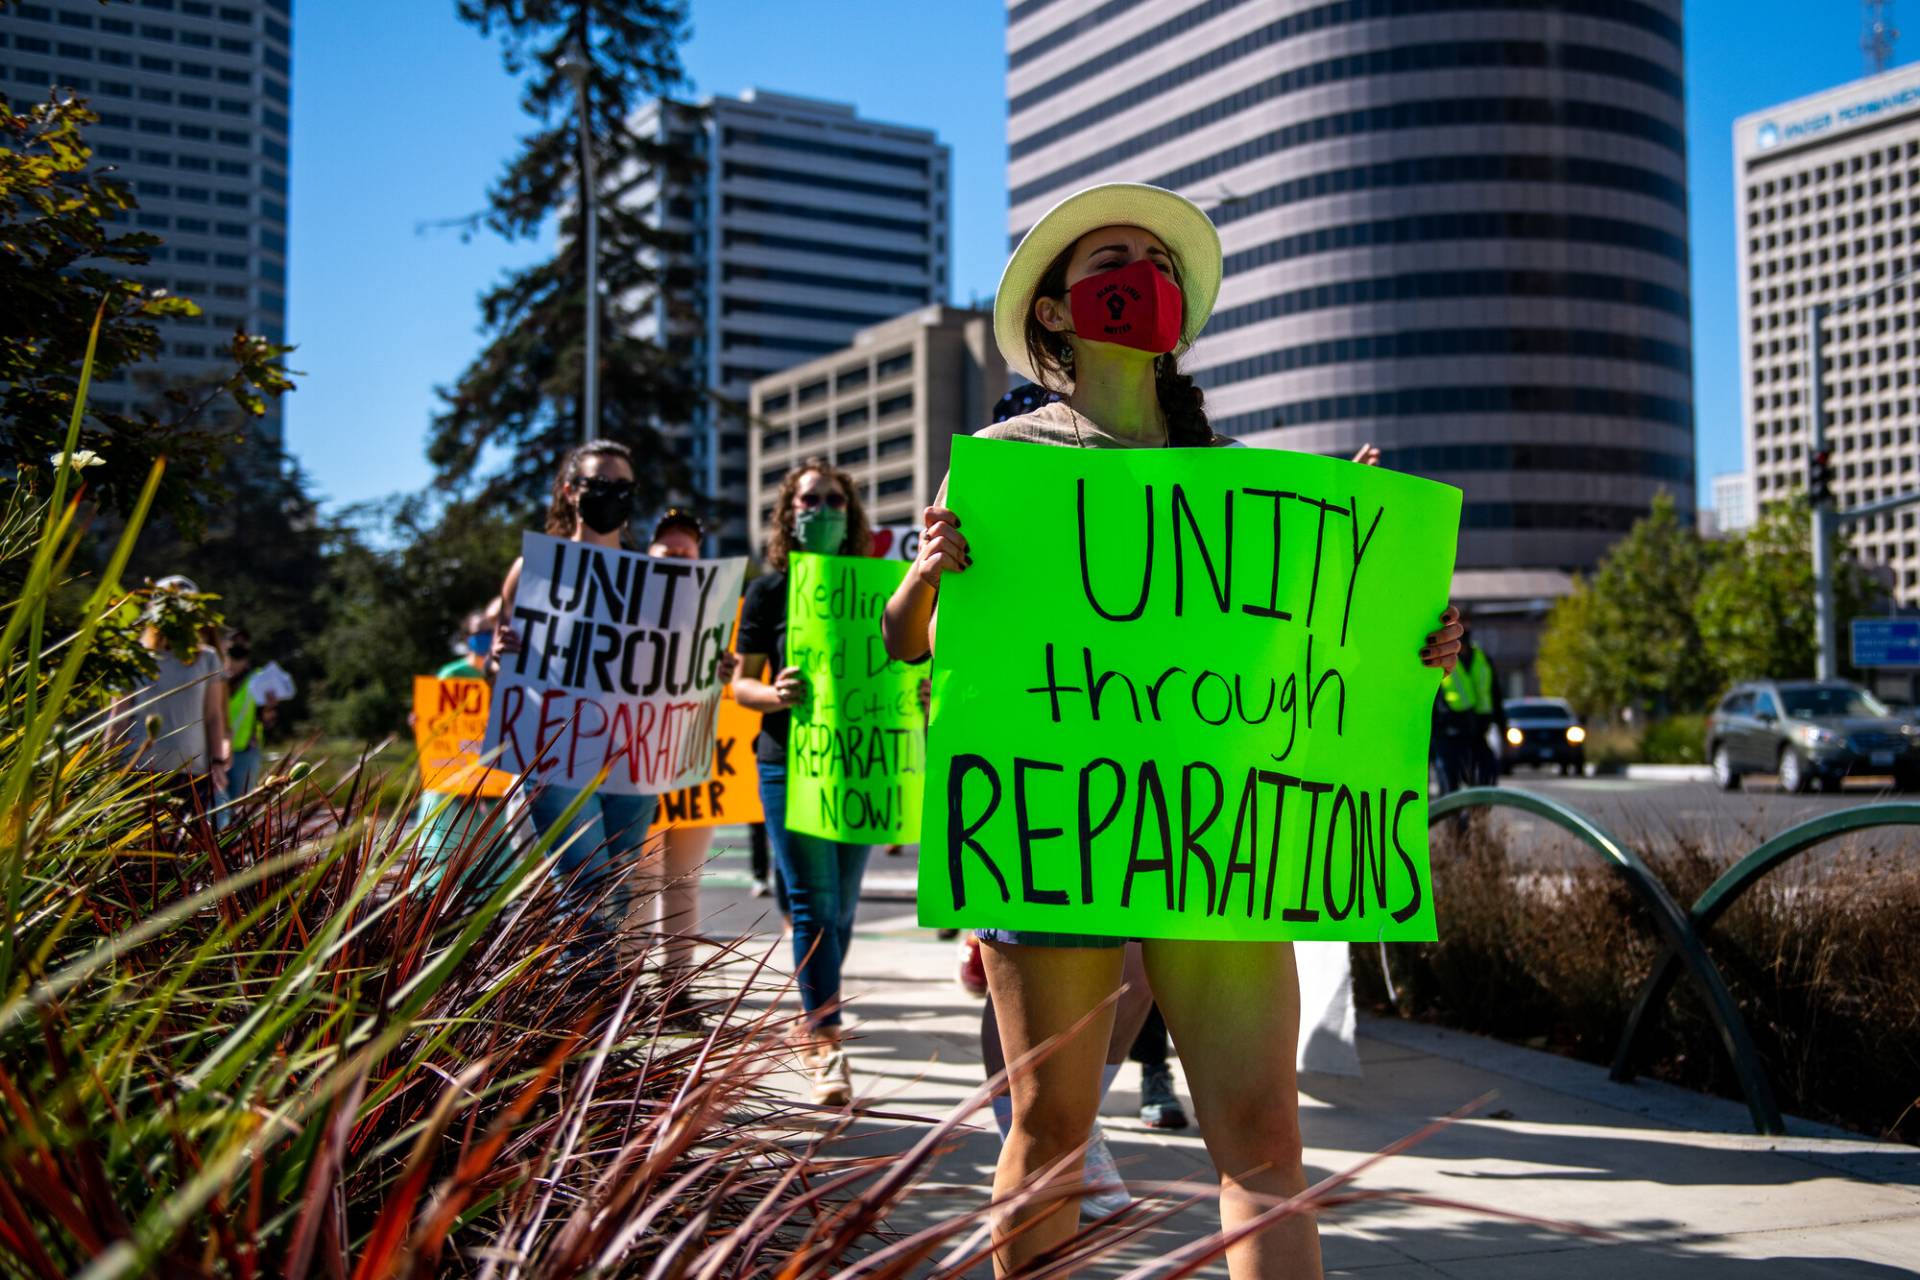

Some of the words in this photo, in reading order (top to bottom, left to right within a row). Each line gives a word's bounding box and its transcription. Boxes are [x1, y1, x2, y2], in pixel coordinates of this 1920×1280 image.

[549, 544, 719, 630] UNITY
[794, 559, 889, 621] Redlin
[1077, 478, 1384, 647] UNITY
[438, 682, 482, 714] NO
[1027, 634, 1345, 761] through
[652, 780, 725, 824] WER
[820, 784, 904, 831] NOW!
[947, 753, 1422, 924] REPARATIONS
